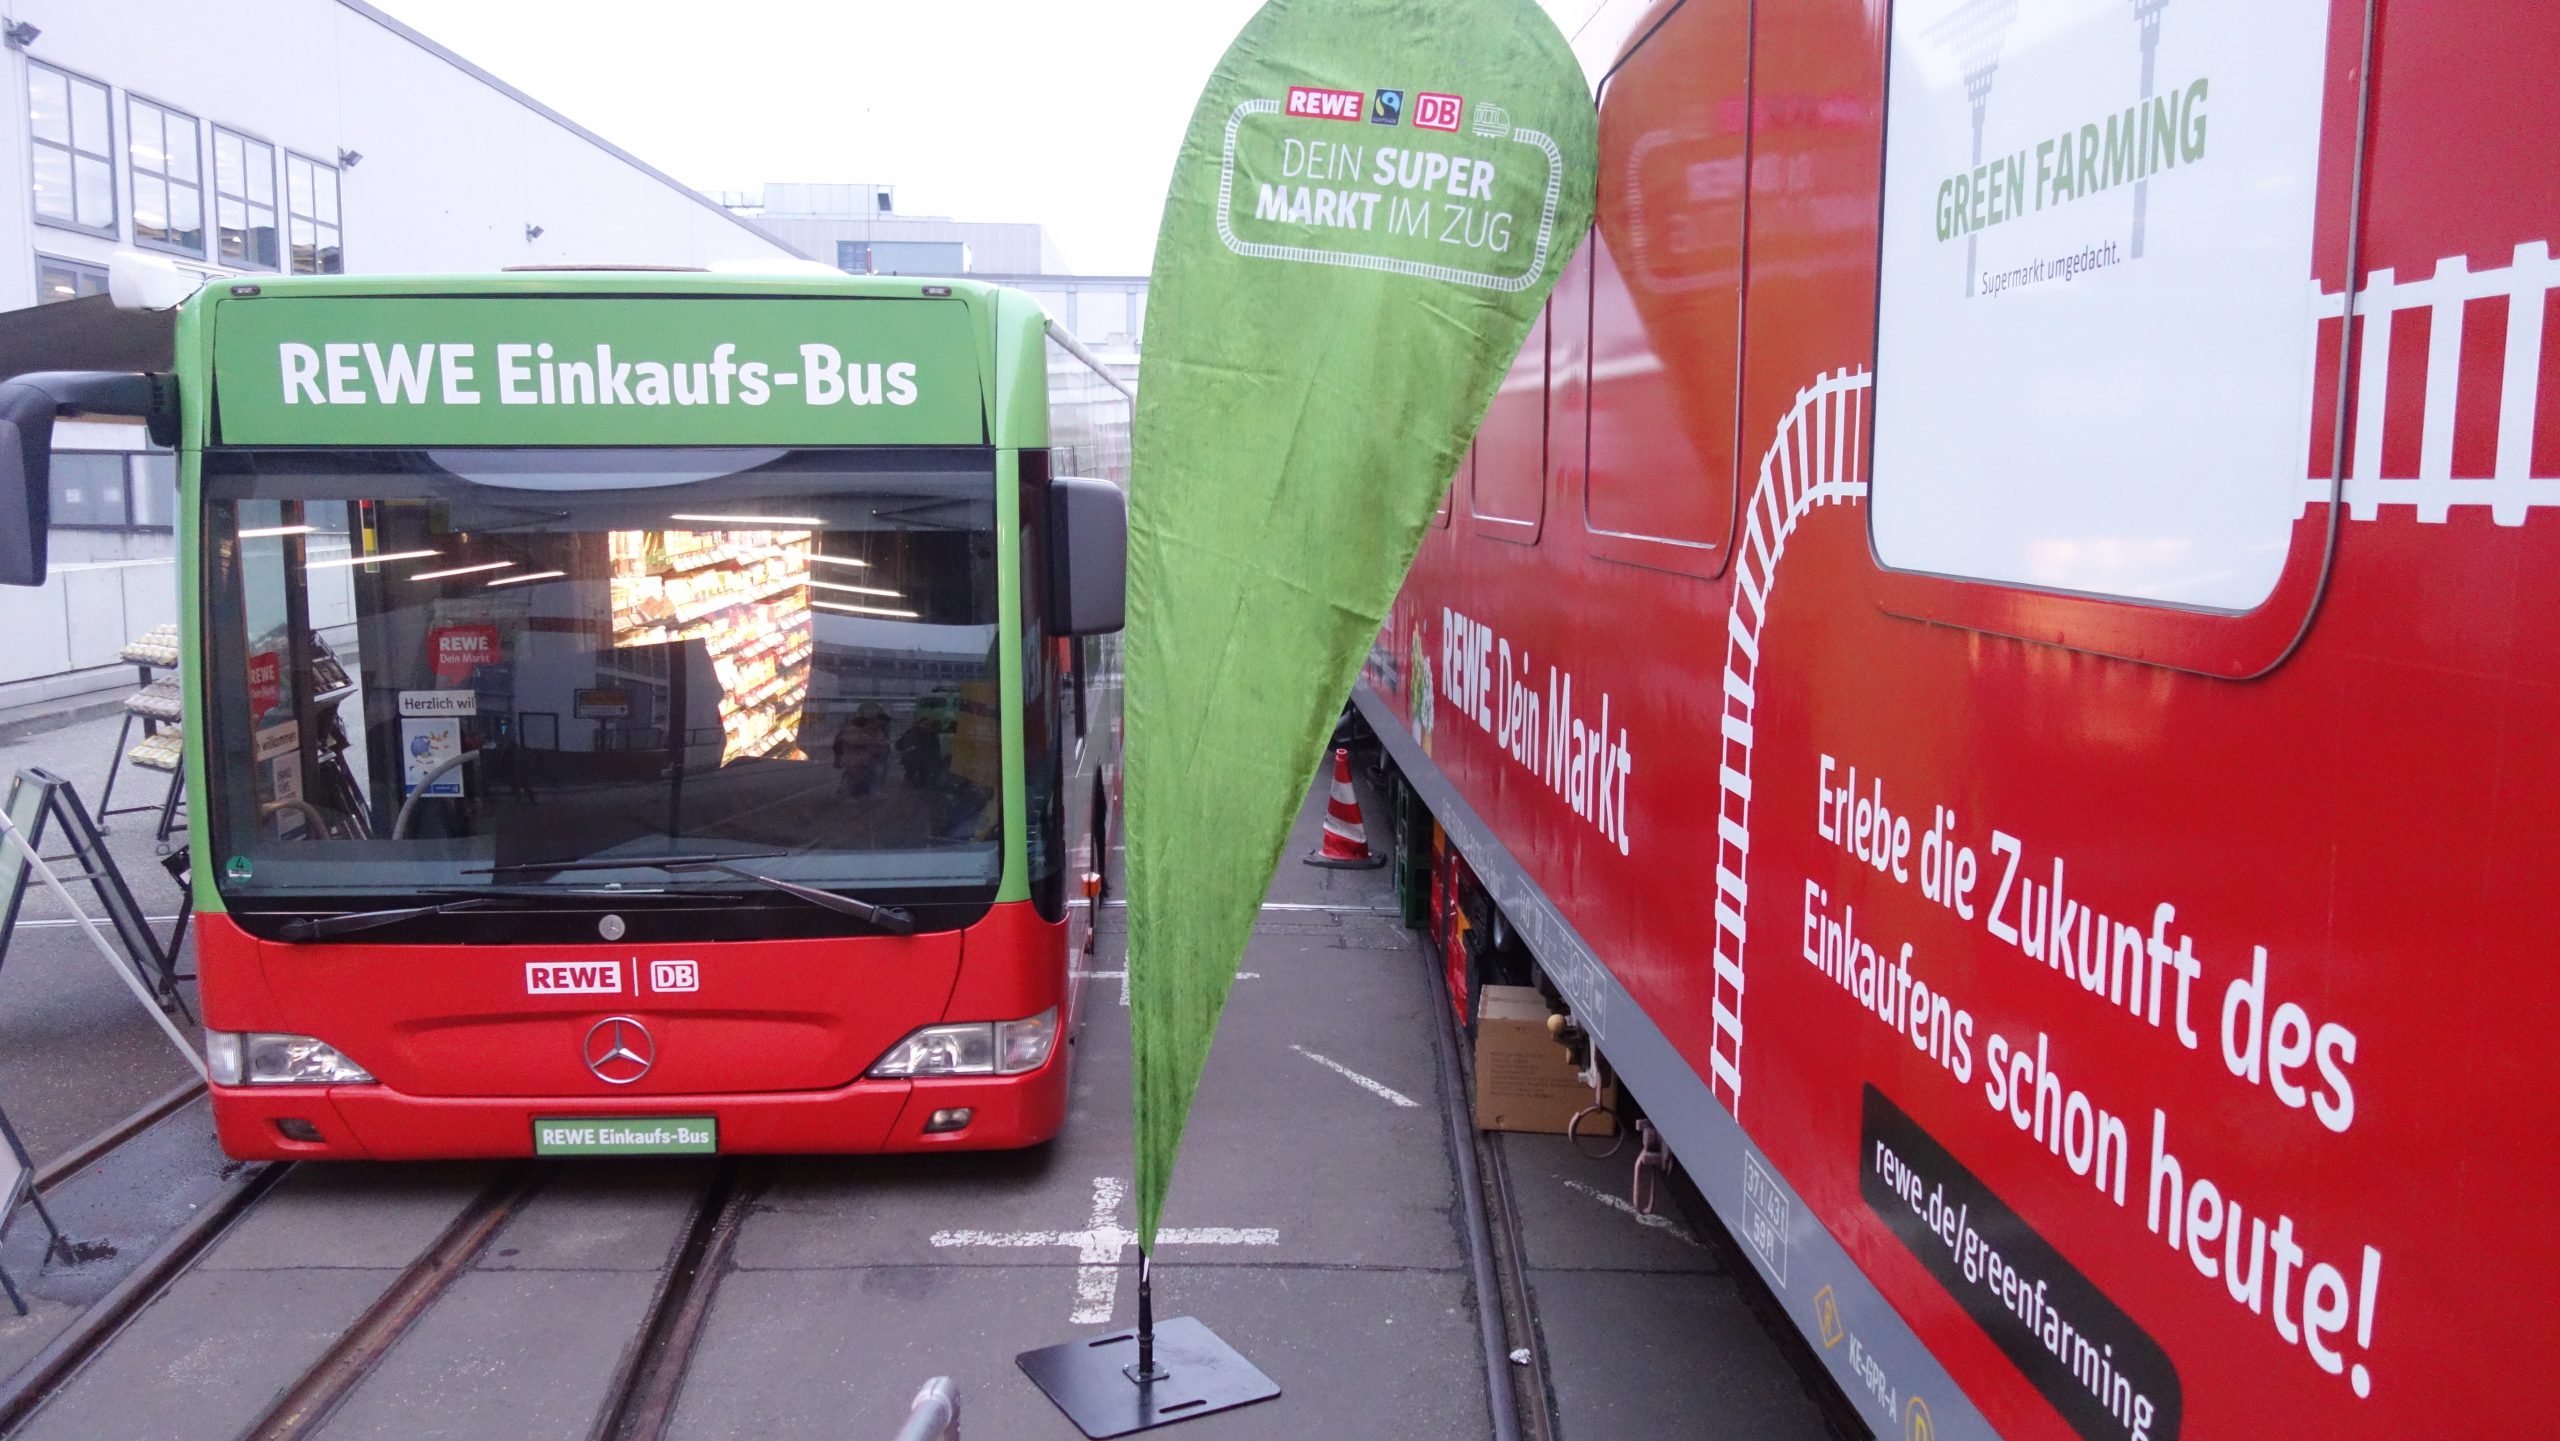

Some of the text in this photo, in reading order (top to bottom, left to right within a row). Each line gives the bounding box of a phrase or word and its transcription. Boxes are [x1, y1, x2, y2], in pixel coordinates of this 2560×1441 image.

[1289, 90, 1360, 118] REWE
[1418, 98, 1457, 126] DB
[1282, 138, 1495, 200] DEIN SUPER
[1936, 78, 2209, 243] GREEN FARMING
[1255, 183, 1514, 253] MARKT IM ZUG
[1982, 240, 2121, 298] Supermarkt umgedacht.
[279, 342, 918, 406] REWE Einkaufs-Bus
[250, 664, 275, 685] REWE
[439, 636, 490, 651] REWE
[439, 652, 490, 664] Dein Markt
[404, 697, 454, 710] Herzlich
[1442, 606, 1492, 733] REWE
[1498, 637, 1539, 776] Dein
[1545, 665, 1631, 857] Markt
[1818, 753, 2357, 1133] Erlebe die Zukunft des
[531, 965, 694, 989] REWE DB
[543, 1127, 710, 1145] REWE Einkaufs-Bus
[1803, 878, 1974, 1085] Einkaufens
[1985, 1032, 2128, 1207] schon
[2147, 1108, 2382, 1400] heute!
[1876, 1139, 2154, 1441] rewe.de/greenfarming
[1849, 1332, 1898, 1423] KE-GPR-A
